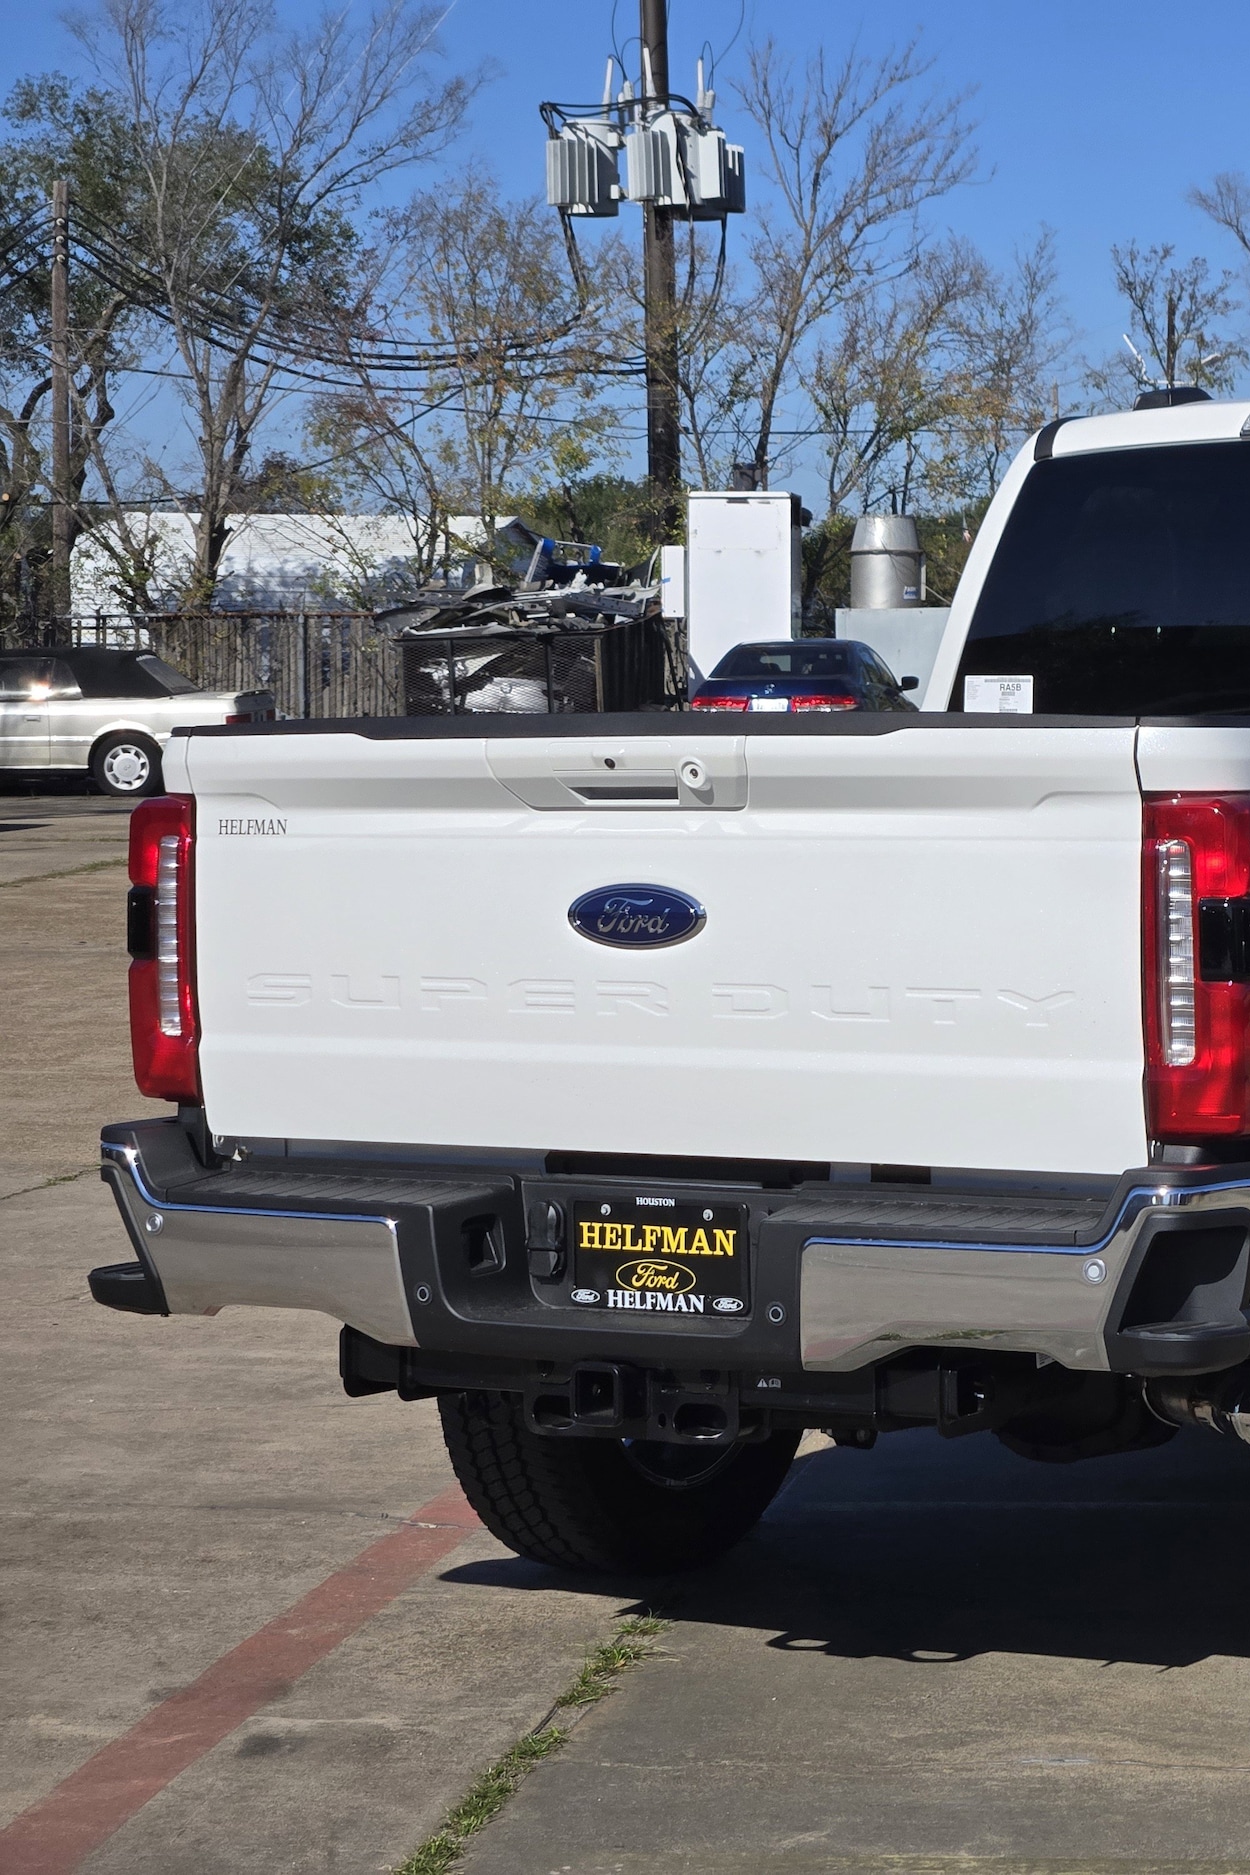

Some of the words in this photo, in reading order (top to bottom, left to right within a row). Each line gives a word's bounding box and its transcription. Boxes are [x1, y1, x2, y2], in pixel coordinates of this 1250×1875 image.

[218, 818, 288, 835] HELFMAN
[597, 896, 671, 934] Ford
[247, 972, 669, 1017] SUPER
[711, 982, 1076, 1026] DUTY
[635, 1196, 676, 1207] HOUSTON
[578, 1221, 737, 1257] HELFMAN
[631, 1262, 680, 1291] Ford
[606, 1289, 706, 1313] HELFMAN
